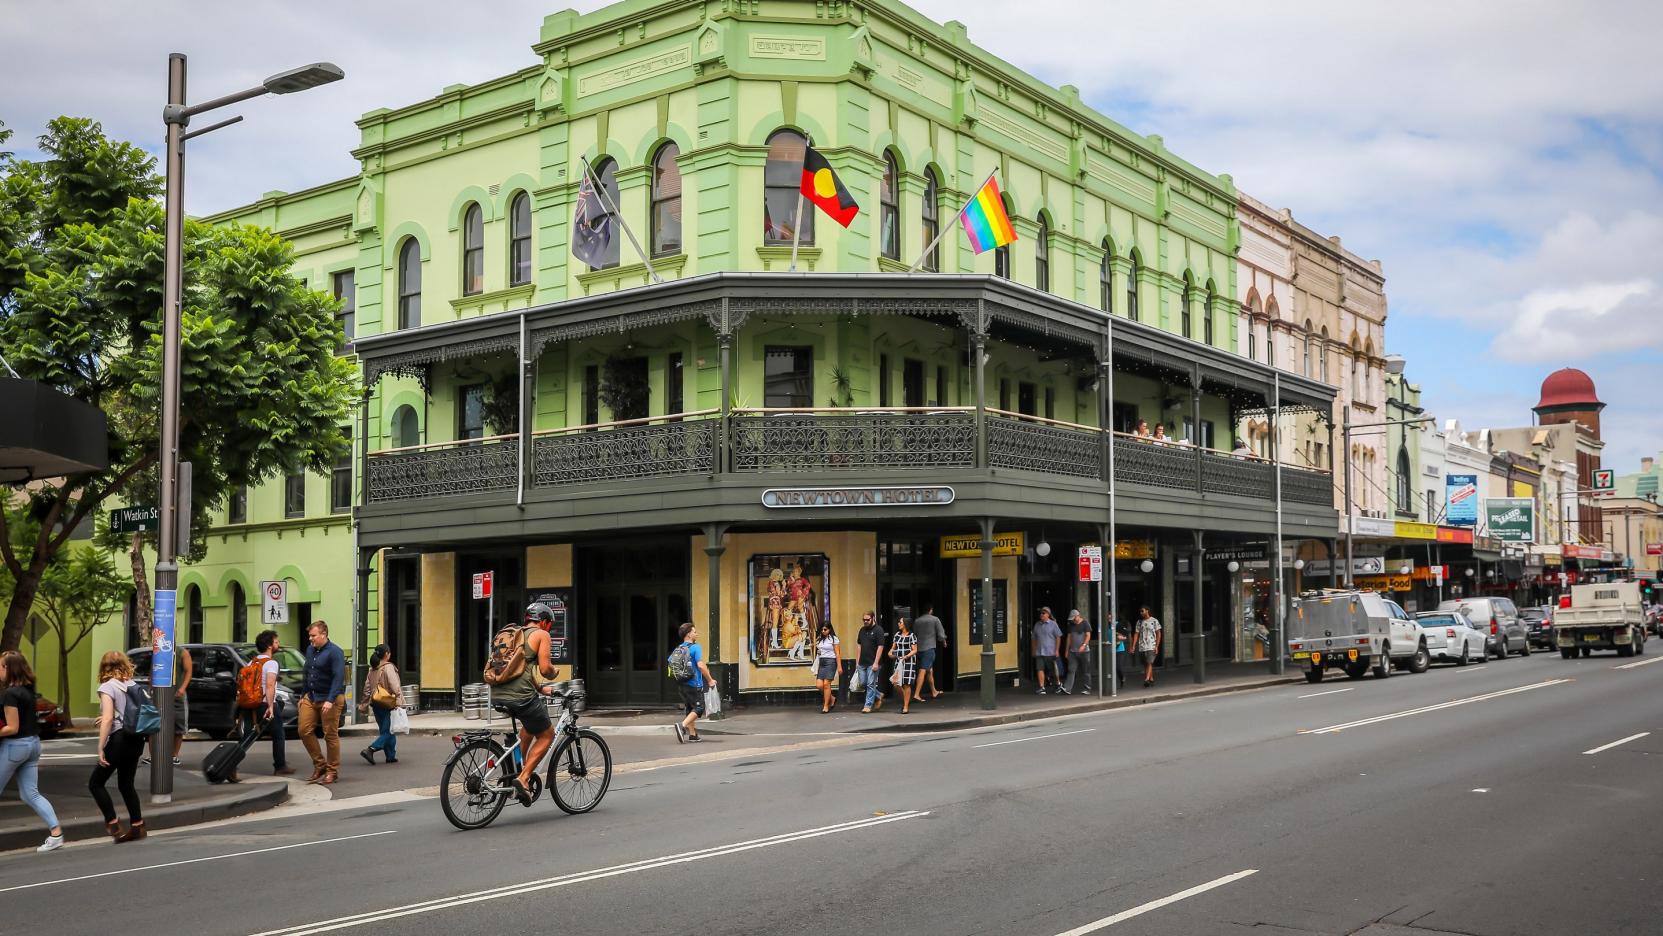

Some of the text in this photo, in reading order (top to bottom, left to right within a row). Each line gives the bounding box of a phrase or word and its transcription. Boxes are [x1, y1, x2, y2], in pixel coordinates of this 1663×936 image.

[775, 489, 943, 505] NEWTOWN HOTEL
[123, 507, 158, 521] Watkin St
[945, 540, 979, 551] NEWTO
[1237, 551, 1263, 559] LOUNGE
[270, 588, 279, 596] 40
